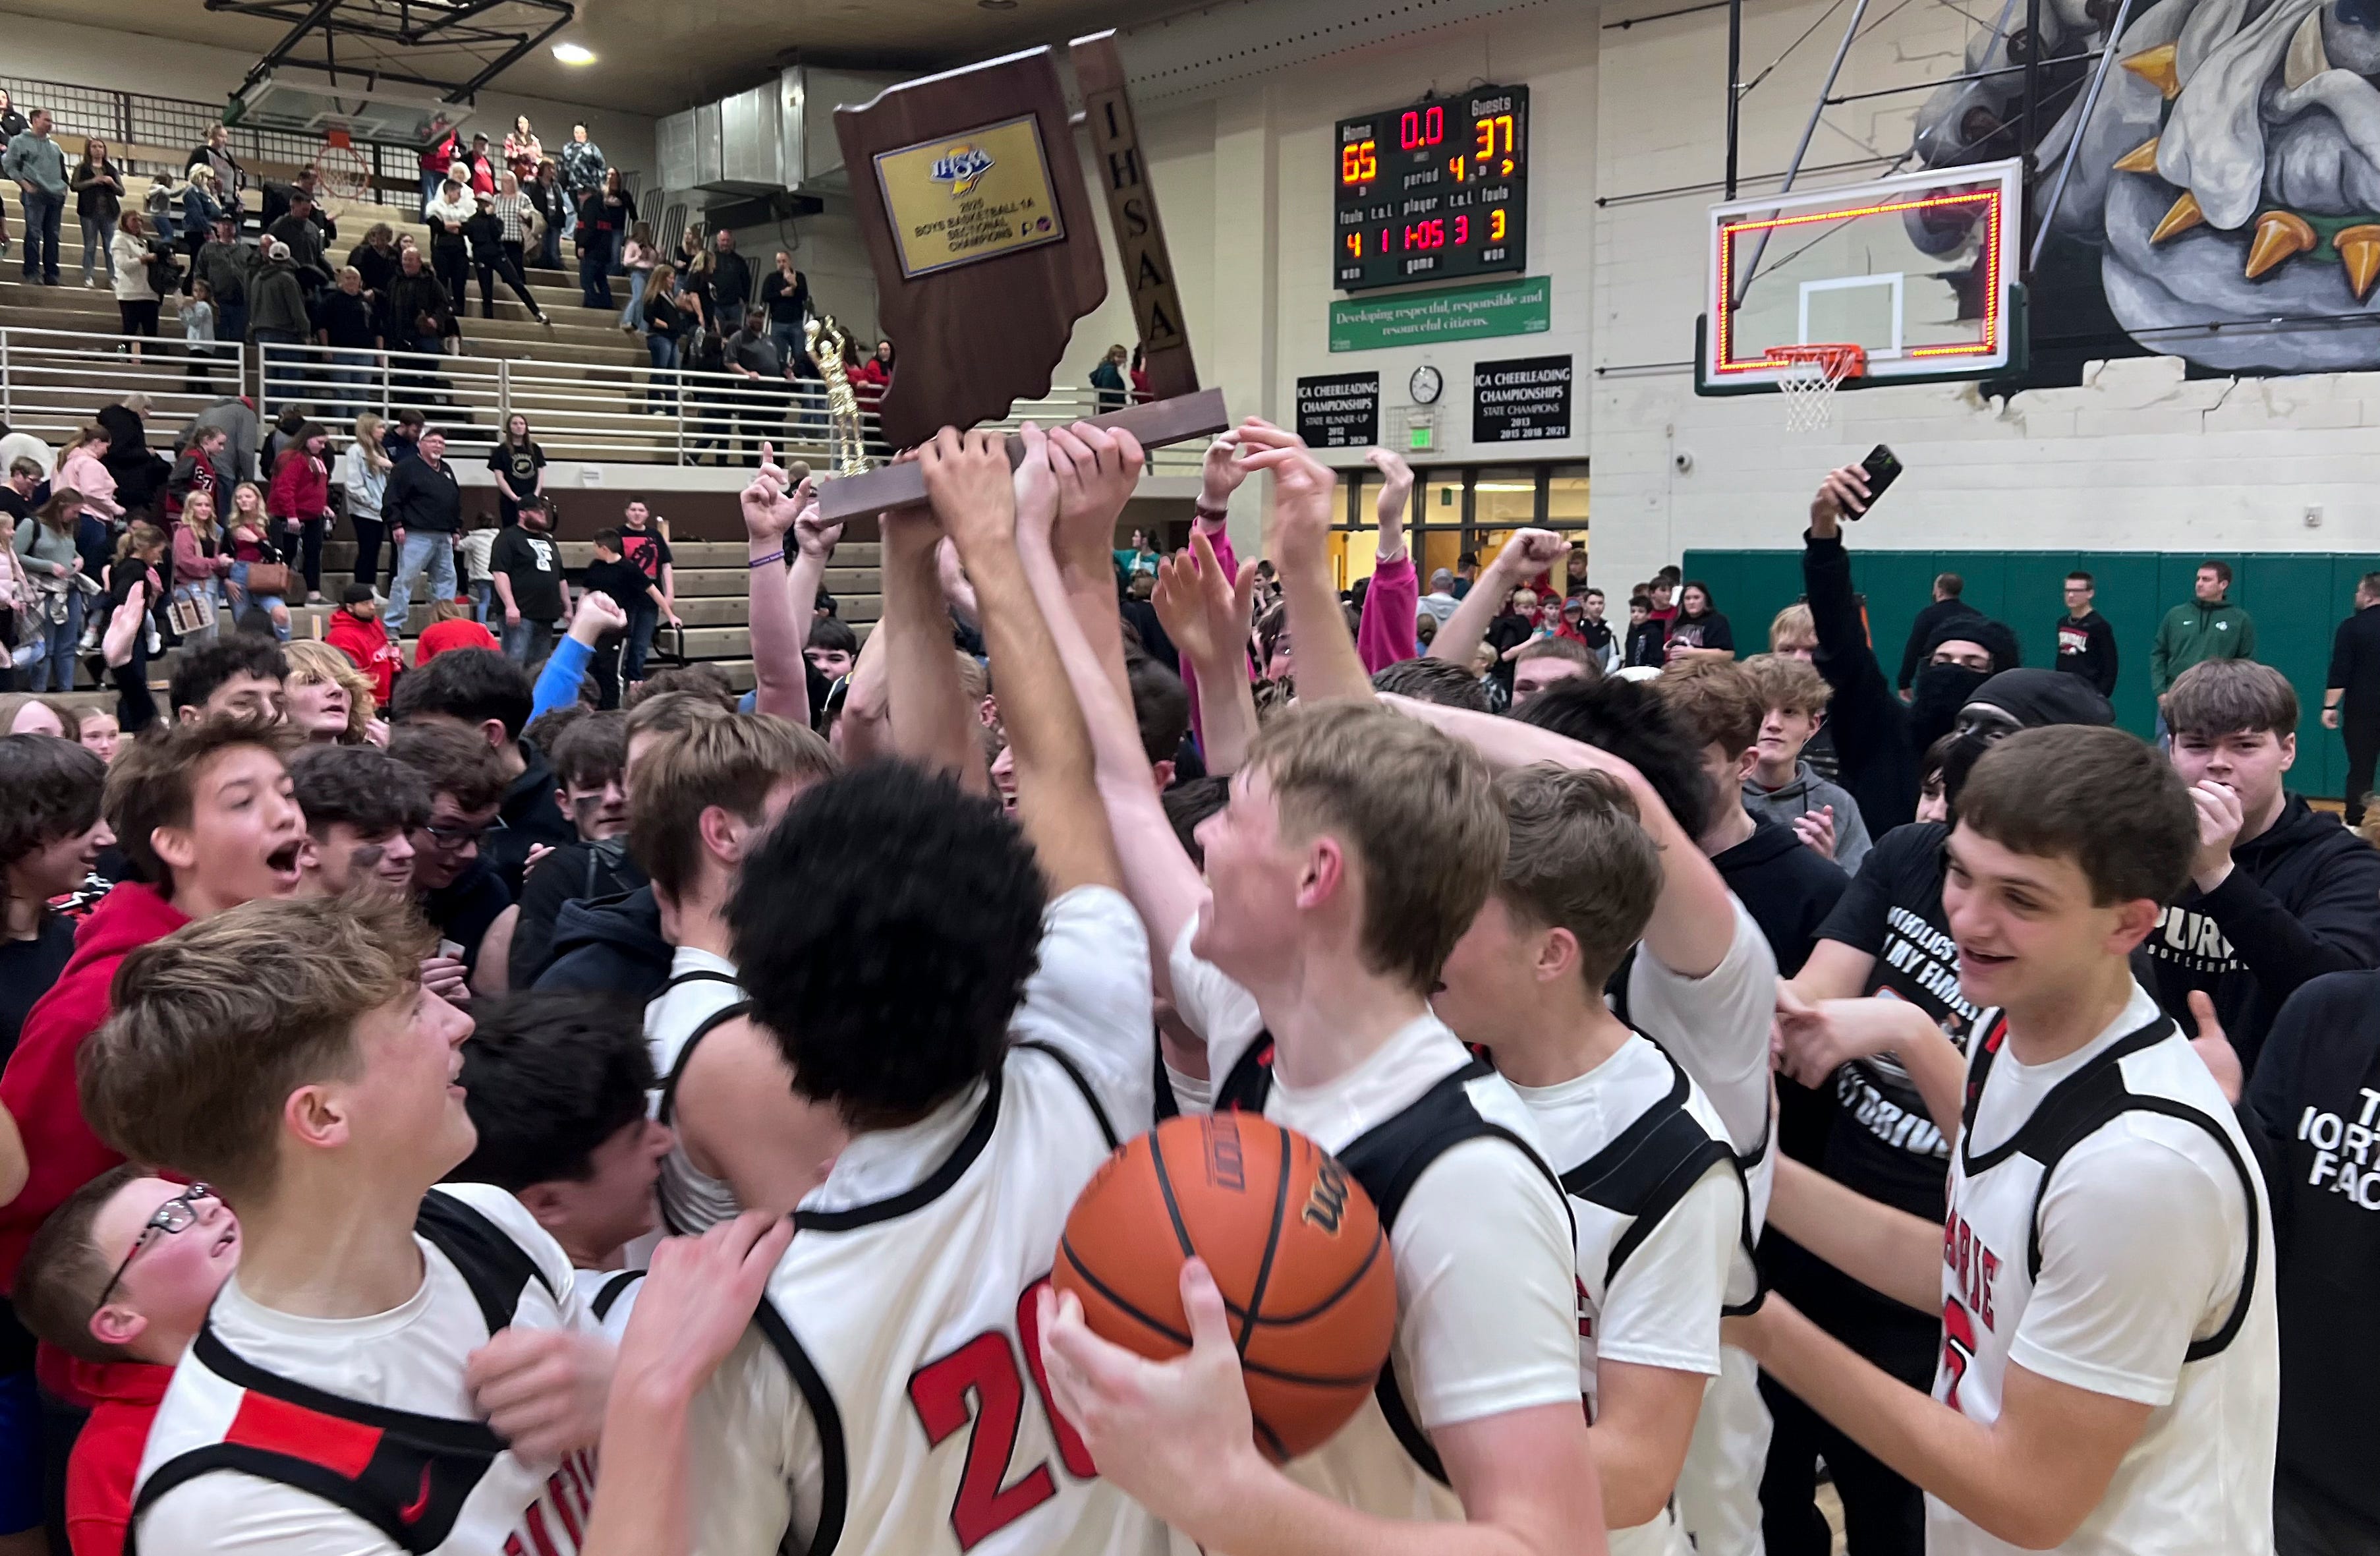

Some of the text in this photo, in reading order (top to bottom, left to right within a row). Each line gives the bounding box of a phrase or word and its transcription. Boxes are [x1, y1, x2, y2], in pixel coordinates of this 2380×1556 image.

[1471, 96, 1512, 117] Guests
[1401, 106, 1443, 150] 0.0
[1475, 115, 1513, 160] 37
[1343, 139, 1377, 185] 65
[1403, 167, 1439, 190] period
[1449, 154, 1464, 183] 4
[1403, 198, 1438, 217] player
[915, 220, 946, 238] BOYS
[947, 202, 1019, 228] BASKETBALL
[1104, 100, 1176, 341] IHSAA
[1347, 231, 1361, 258] 4
[1382, 228, 1389, 253] 1
[1454, 215, 1469, 245] 3
[1490, 208, 1506, 241] 3
[1336, 310, 1394, 324] Developing
[1453, 292, 1517, 313] responsible
[1520, 289, 1543, 304] and
[1382, 317, 1441, 335] resourceful
[1475, 368, 1571, 387] ICA CHEERLEADING
[1314, 382, 1378, 397] CHEERLEADING
[1480, 386, 1564, 403] CHAMPIONSHIPS
[1302, 397, 1373, 413] CHAMPIONSHIPS
[1483, 403, 1560, 417] STATE CHAMPIONS
[1305, 417, 1323, 426] STATE
[1511, 417, 1530, 427] 2013
[1546, 426, 1566, 436] 2021
